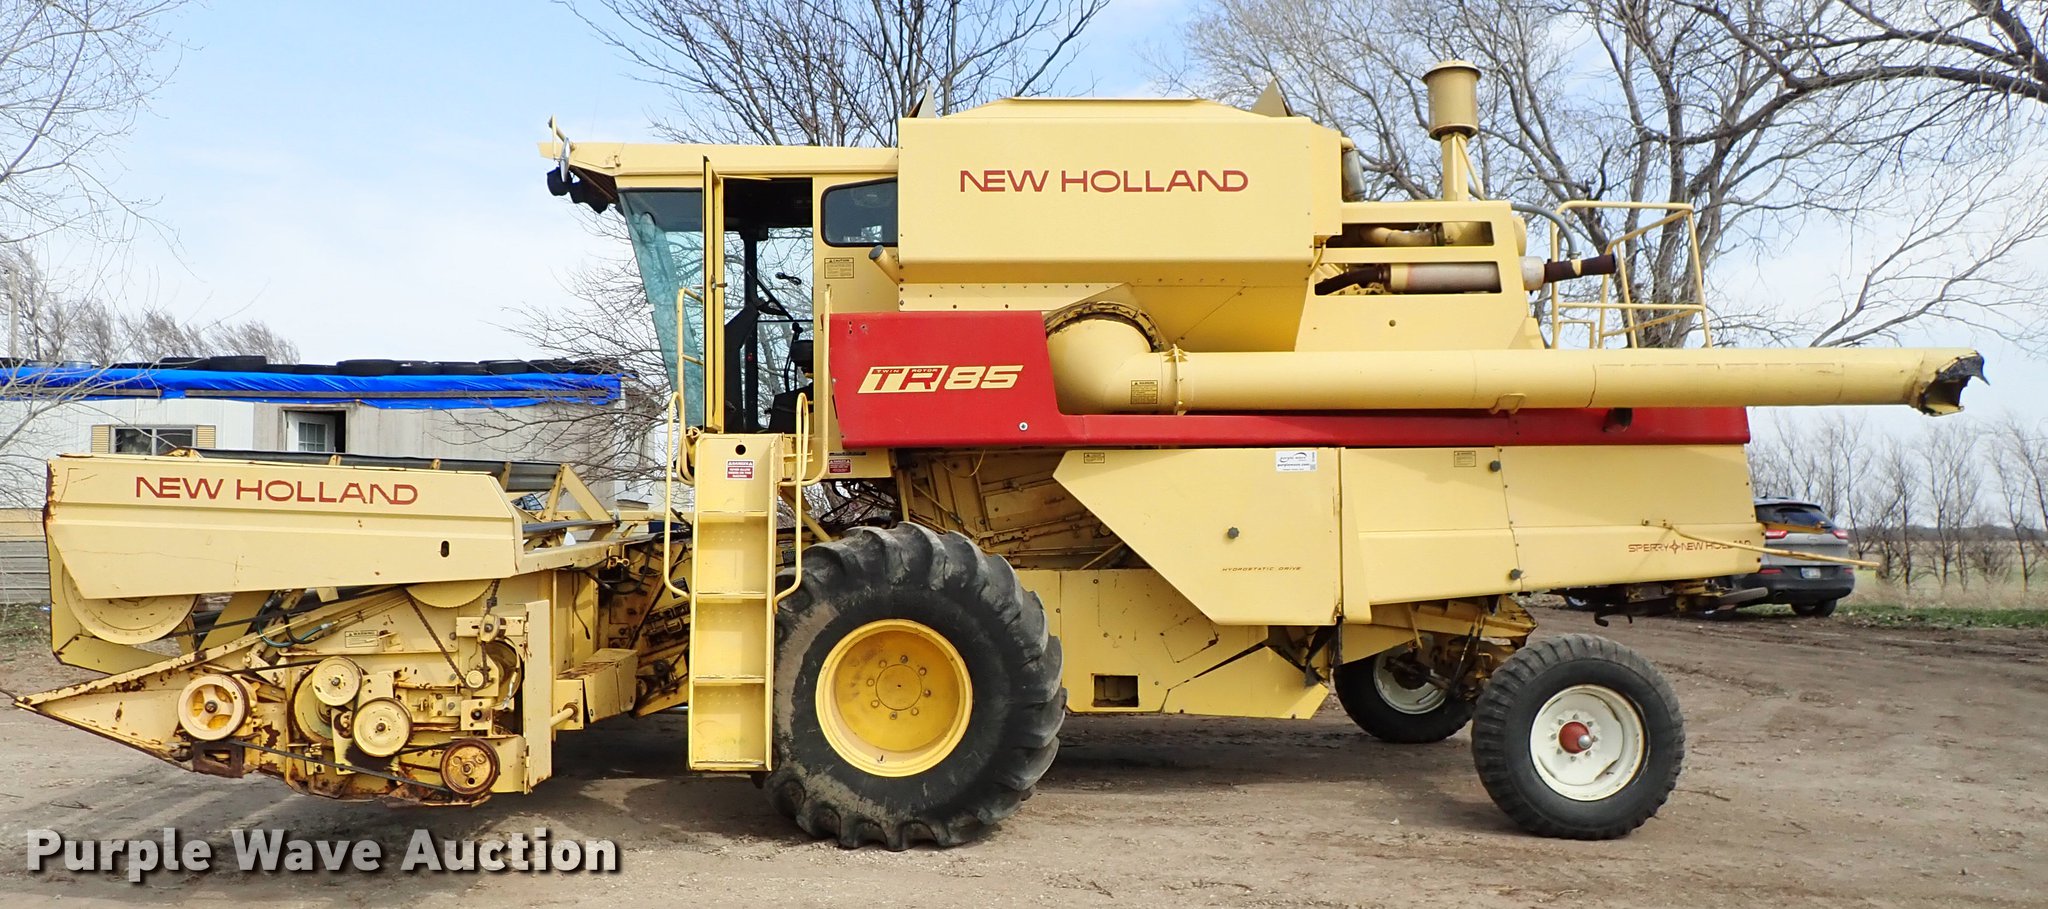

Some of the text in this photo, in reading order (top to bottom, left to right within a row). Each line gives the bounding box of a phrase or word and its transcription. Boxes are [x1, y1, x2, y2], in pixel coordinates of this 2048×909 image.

[959, 170, 1249, 193] NEW HOLLAND
[136, 477, 418, 506] NEW HOLLAND
[1628, 543, 1669, 553] SPERRY
[1681, 541, 1703, 551] NEW
